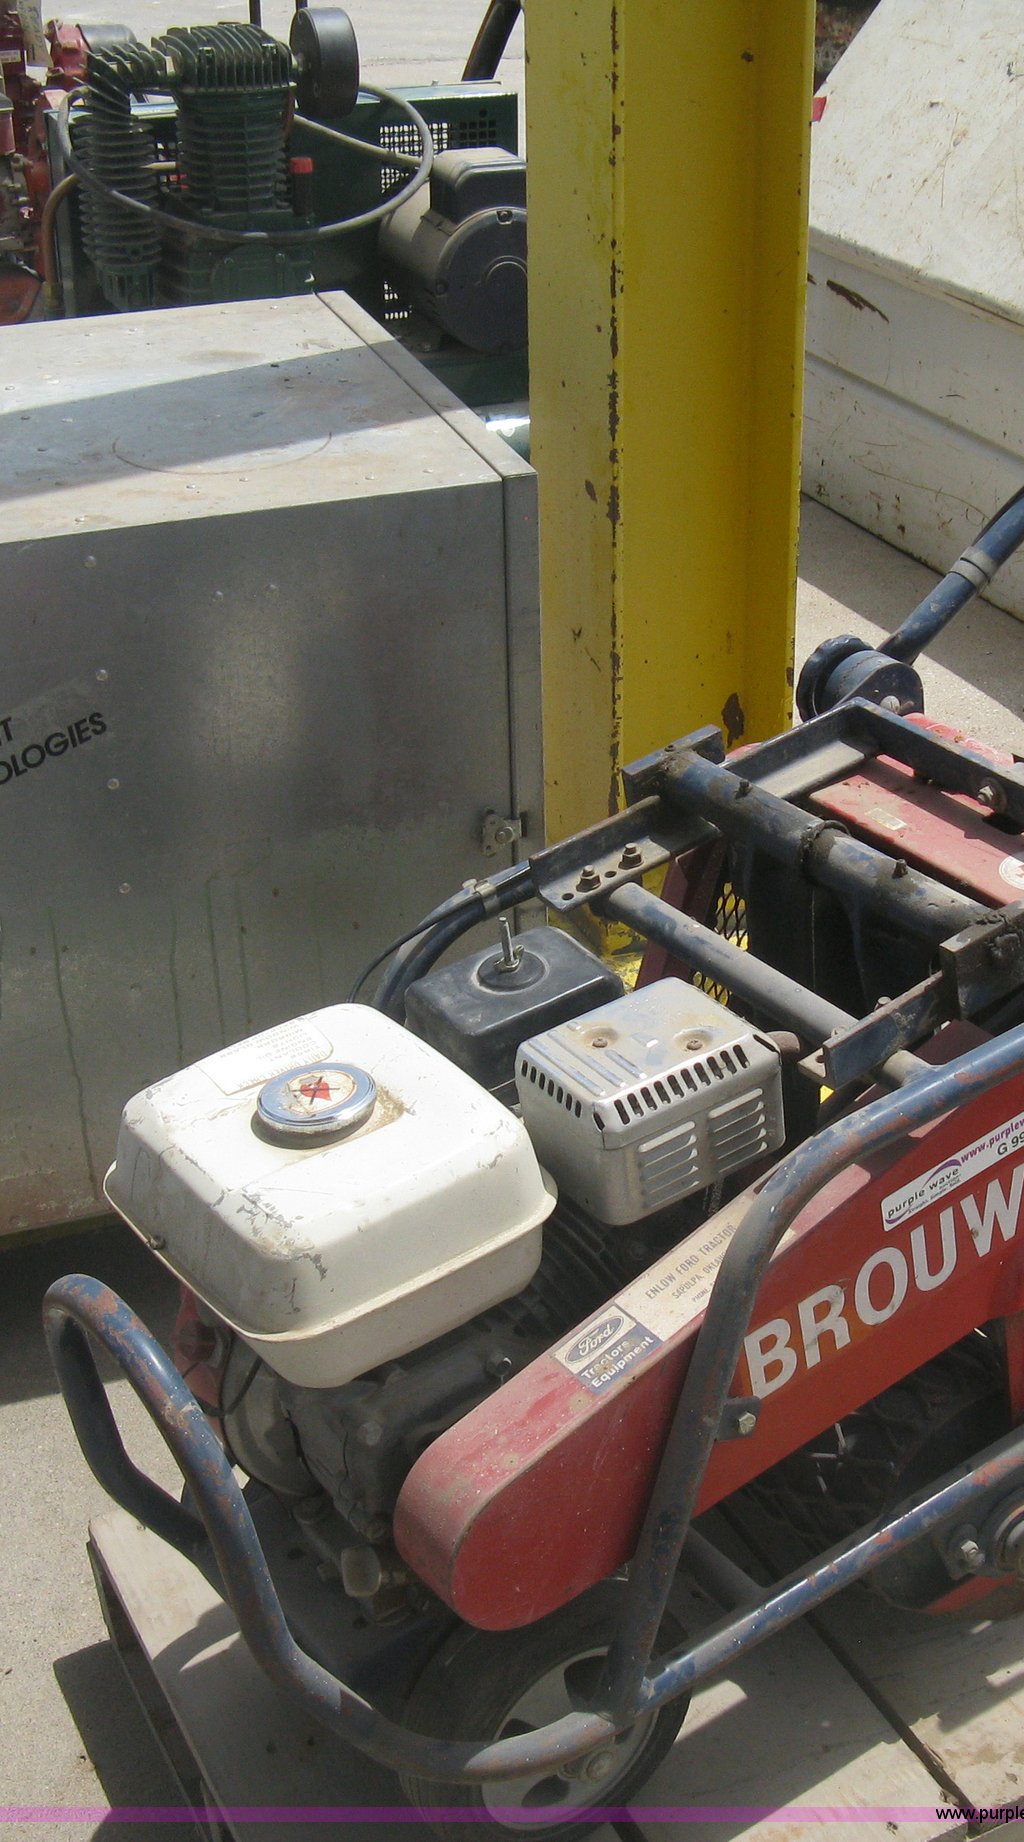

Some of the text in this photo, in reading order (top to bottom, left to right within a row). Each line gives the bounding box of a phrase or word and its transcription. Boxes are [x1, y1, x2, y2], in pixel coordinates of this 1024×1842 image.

[997, 1143, 1009, 1156] G
[887, 1168, 959, 1218] purple wave
[645, 1224, 738, 1299] ENLOW FORD TRACTOR
[577, 1323, 615, 1356] Ford
[581, 1340, 630, 1379] Tractors
[591, 1335, 655, 1388] Equipment
